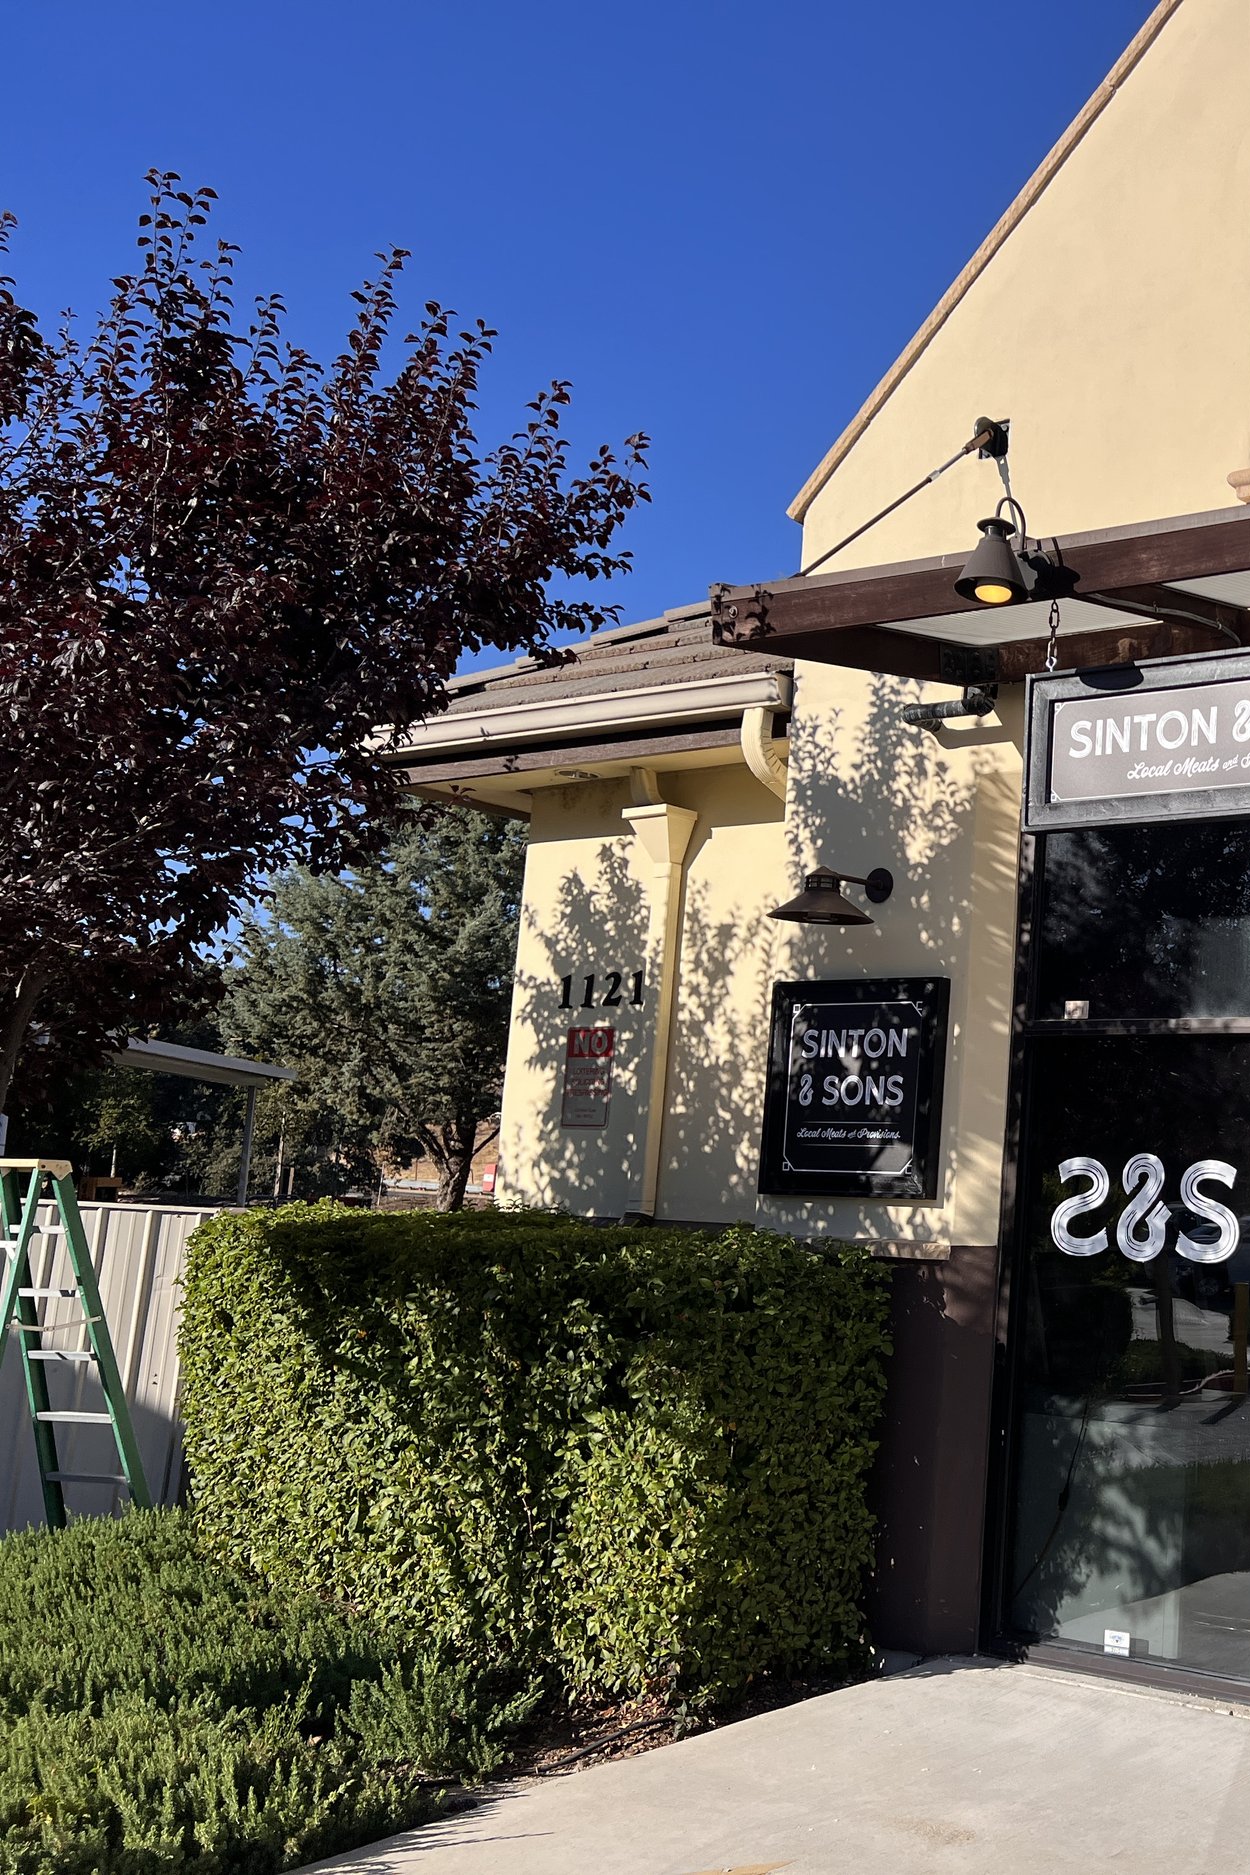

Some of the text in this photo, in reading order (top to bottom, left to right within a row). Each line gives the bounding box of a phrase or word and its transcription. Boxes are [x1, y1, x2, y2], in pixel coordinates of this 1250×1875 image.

[1068, 706, 1218, 758] SINTON
[1127, 760, 1173, 779] Local
[1173, 757, 1220, 777] Meats
[1222, 754, 1239, 771] and
[557, 969, 644, 1009] 1121
[573, 1030, 608, 1055] NO
[801, 1028, 909, 1059] SINTON
[798, 1073, 905, 1107] & SONS
[796, 1127, 822, 1138] Local
[821, 1127, 847, 1141] Meats
[857, 1127, 901, 1139] Provisions
